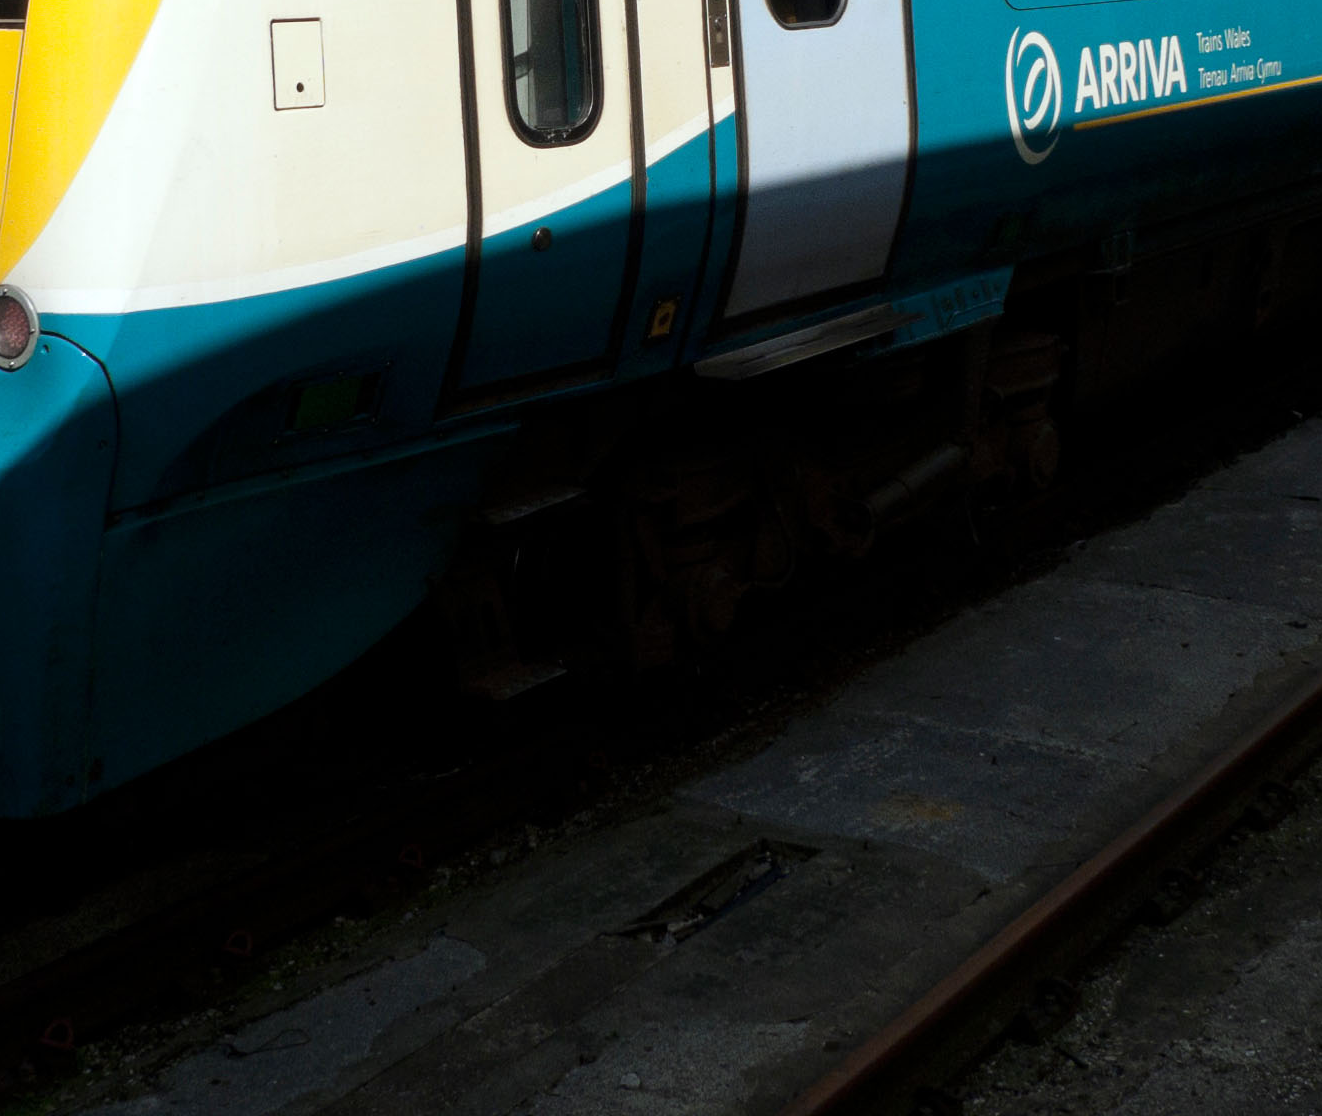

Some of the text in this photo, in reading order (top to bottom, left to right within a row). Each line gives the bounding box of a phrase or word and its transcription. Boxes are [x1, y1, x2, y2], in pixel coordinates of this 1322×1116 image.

[1196, 26, 1251, 54] Trains Wales
[1074, 35, 1188, 113] ARRIVA
[1198, 57, 1282, 89] Trenau Arriva Cymru
